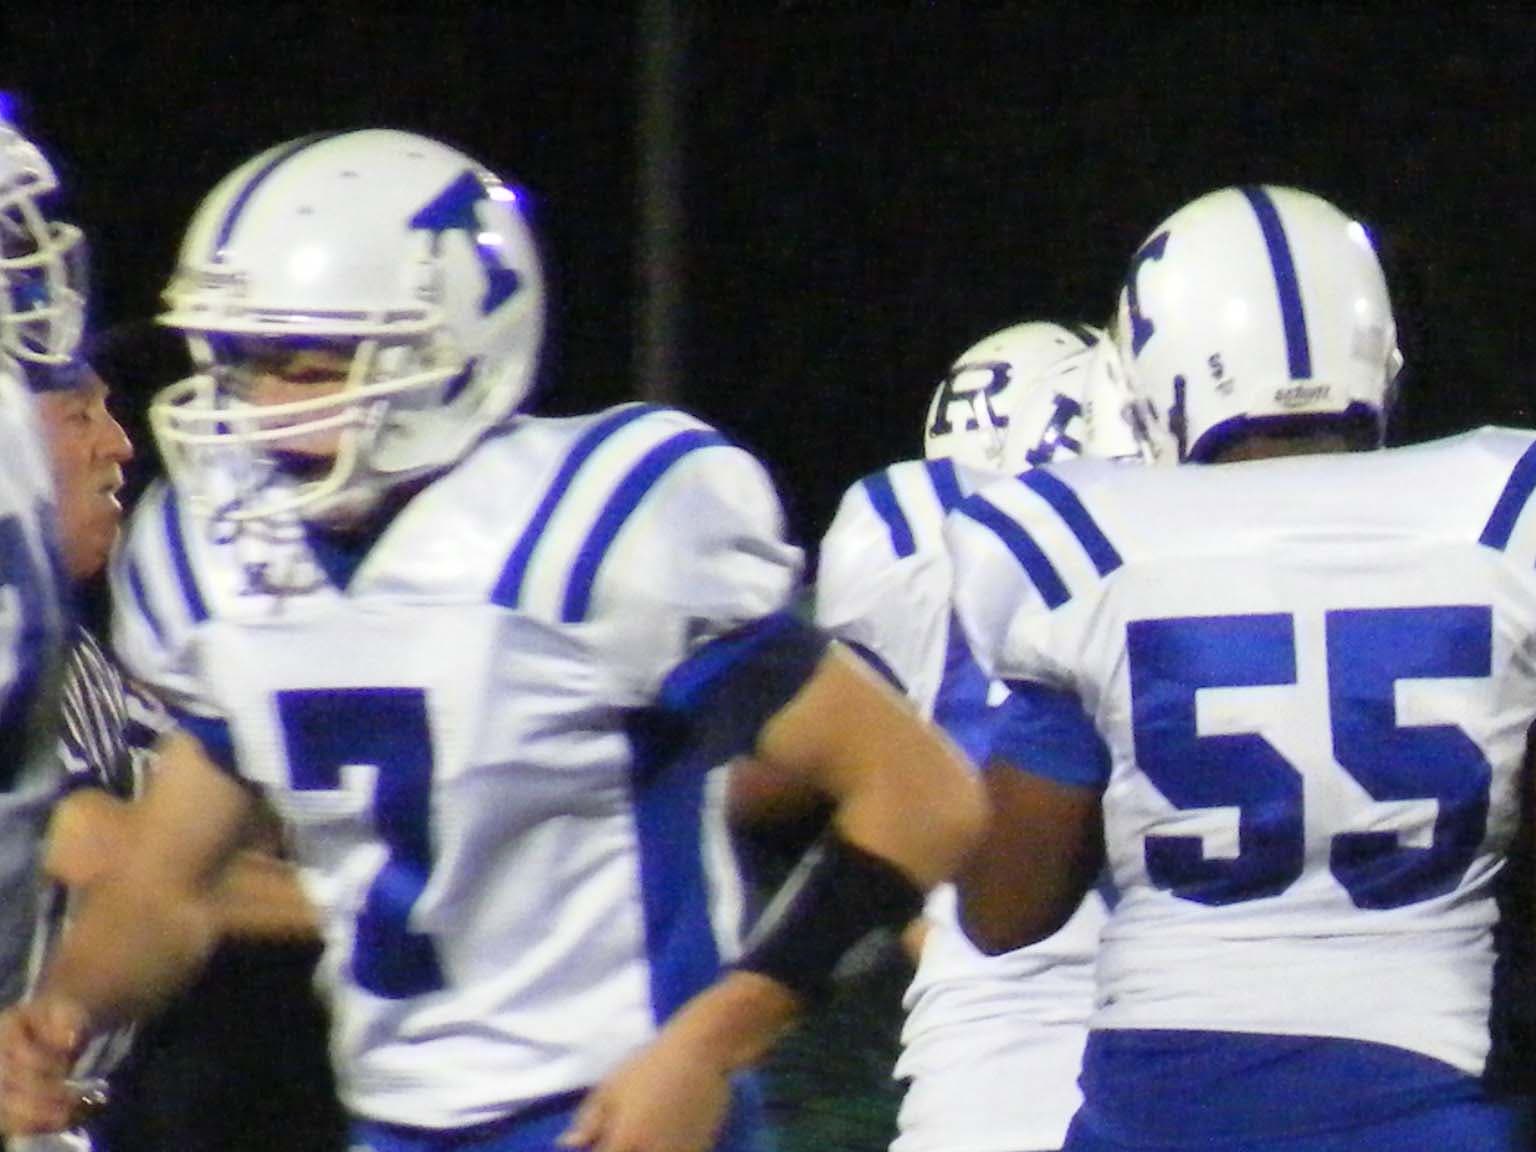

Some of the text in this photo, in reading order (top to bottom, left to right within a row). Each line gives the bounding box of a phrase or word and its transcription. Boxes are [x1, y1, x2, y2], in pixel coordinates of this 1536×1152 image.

[930, 361, 1011, 438] R
[273, 687, 450, 1000] 7
[1127, 605, 1494, 909] 55
